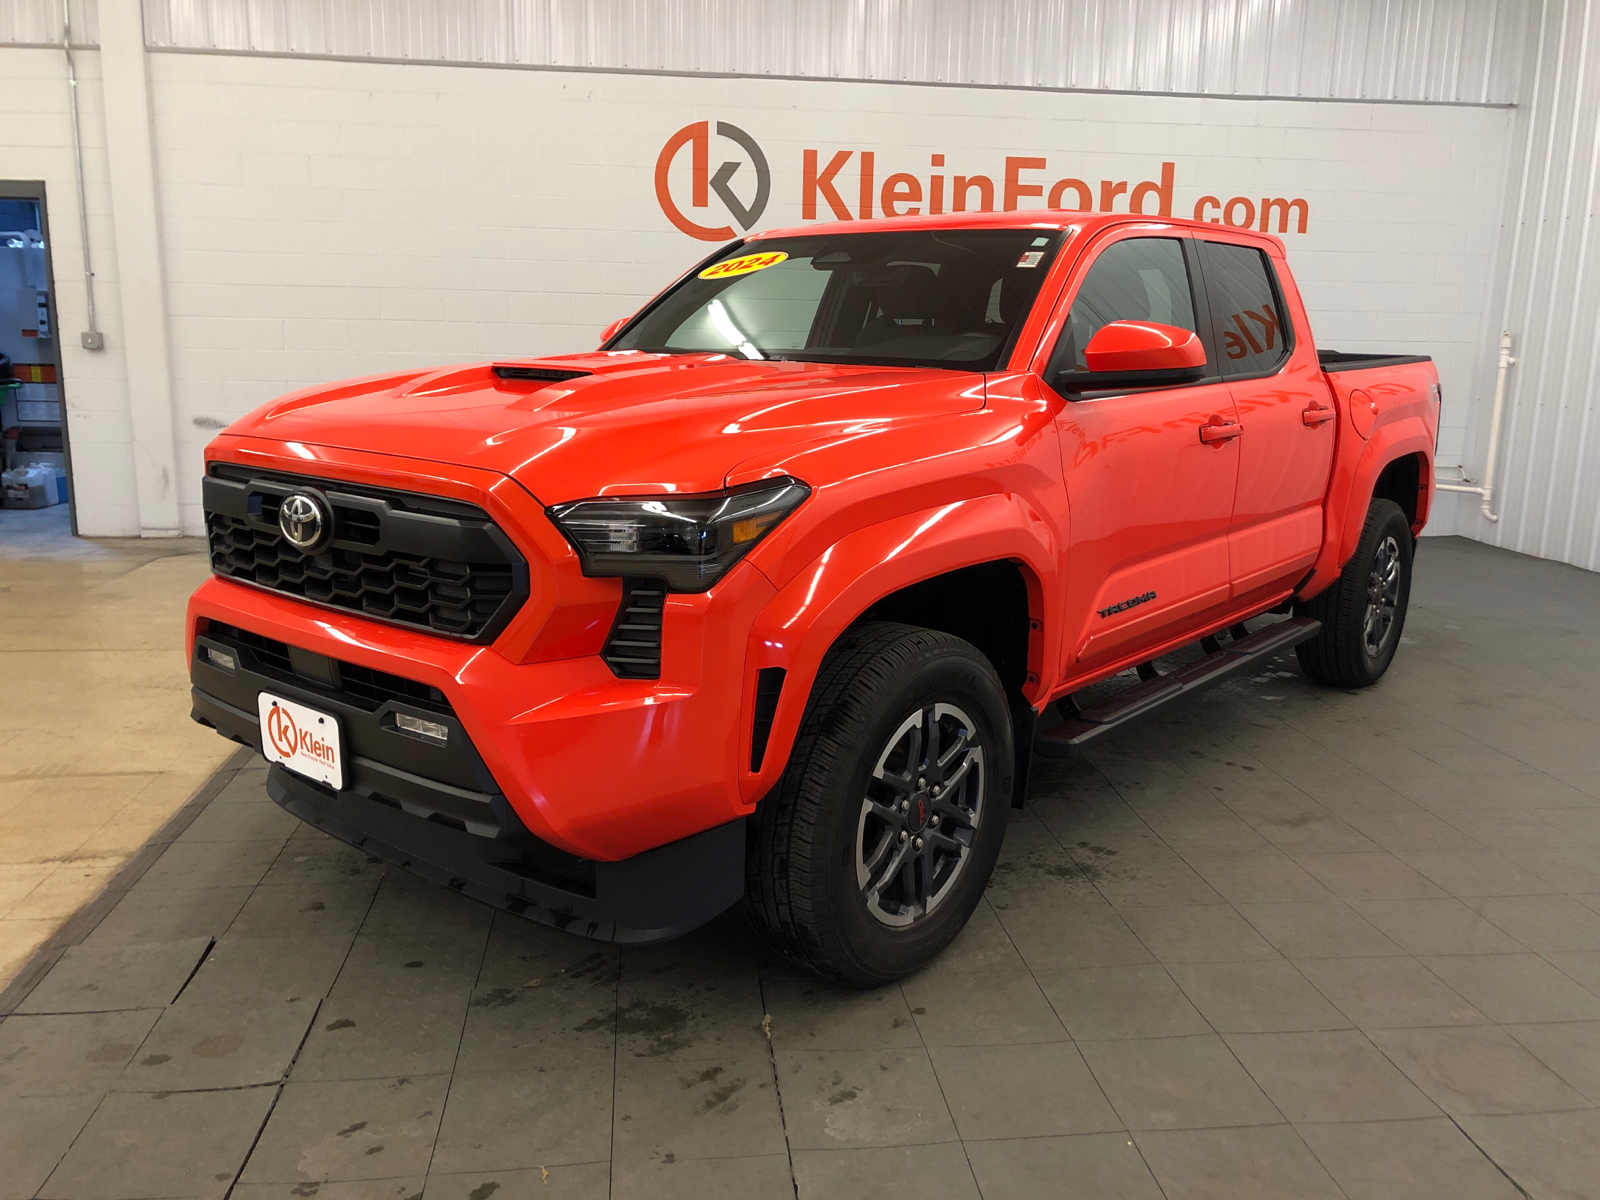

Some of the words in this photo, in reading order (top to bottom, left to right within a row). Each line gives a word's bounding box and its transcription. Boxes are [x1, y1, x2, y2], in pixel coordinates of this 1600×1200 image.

[704, 254, 782, 277] 2024
[1097, 589, 1157, 619] TACOMA
[299, 727, 335, 764] Klein
